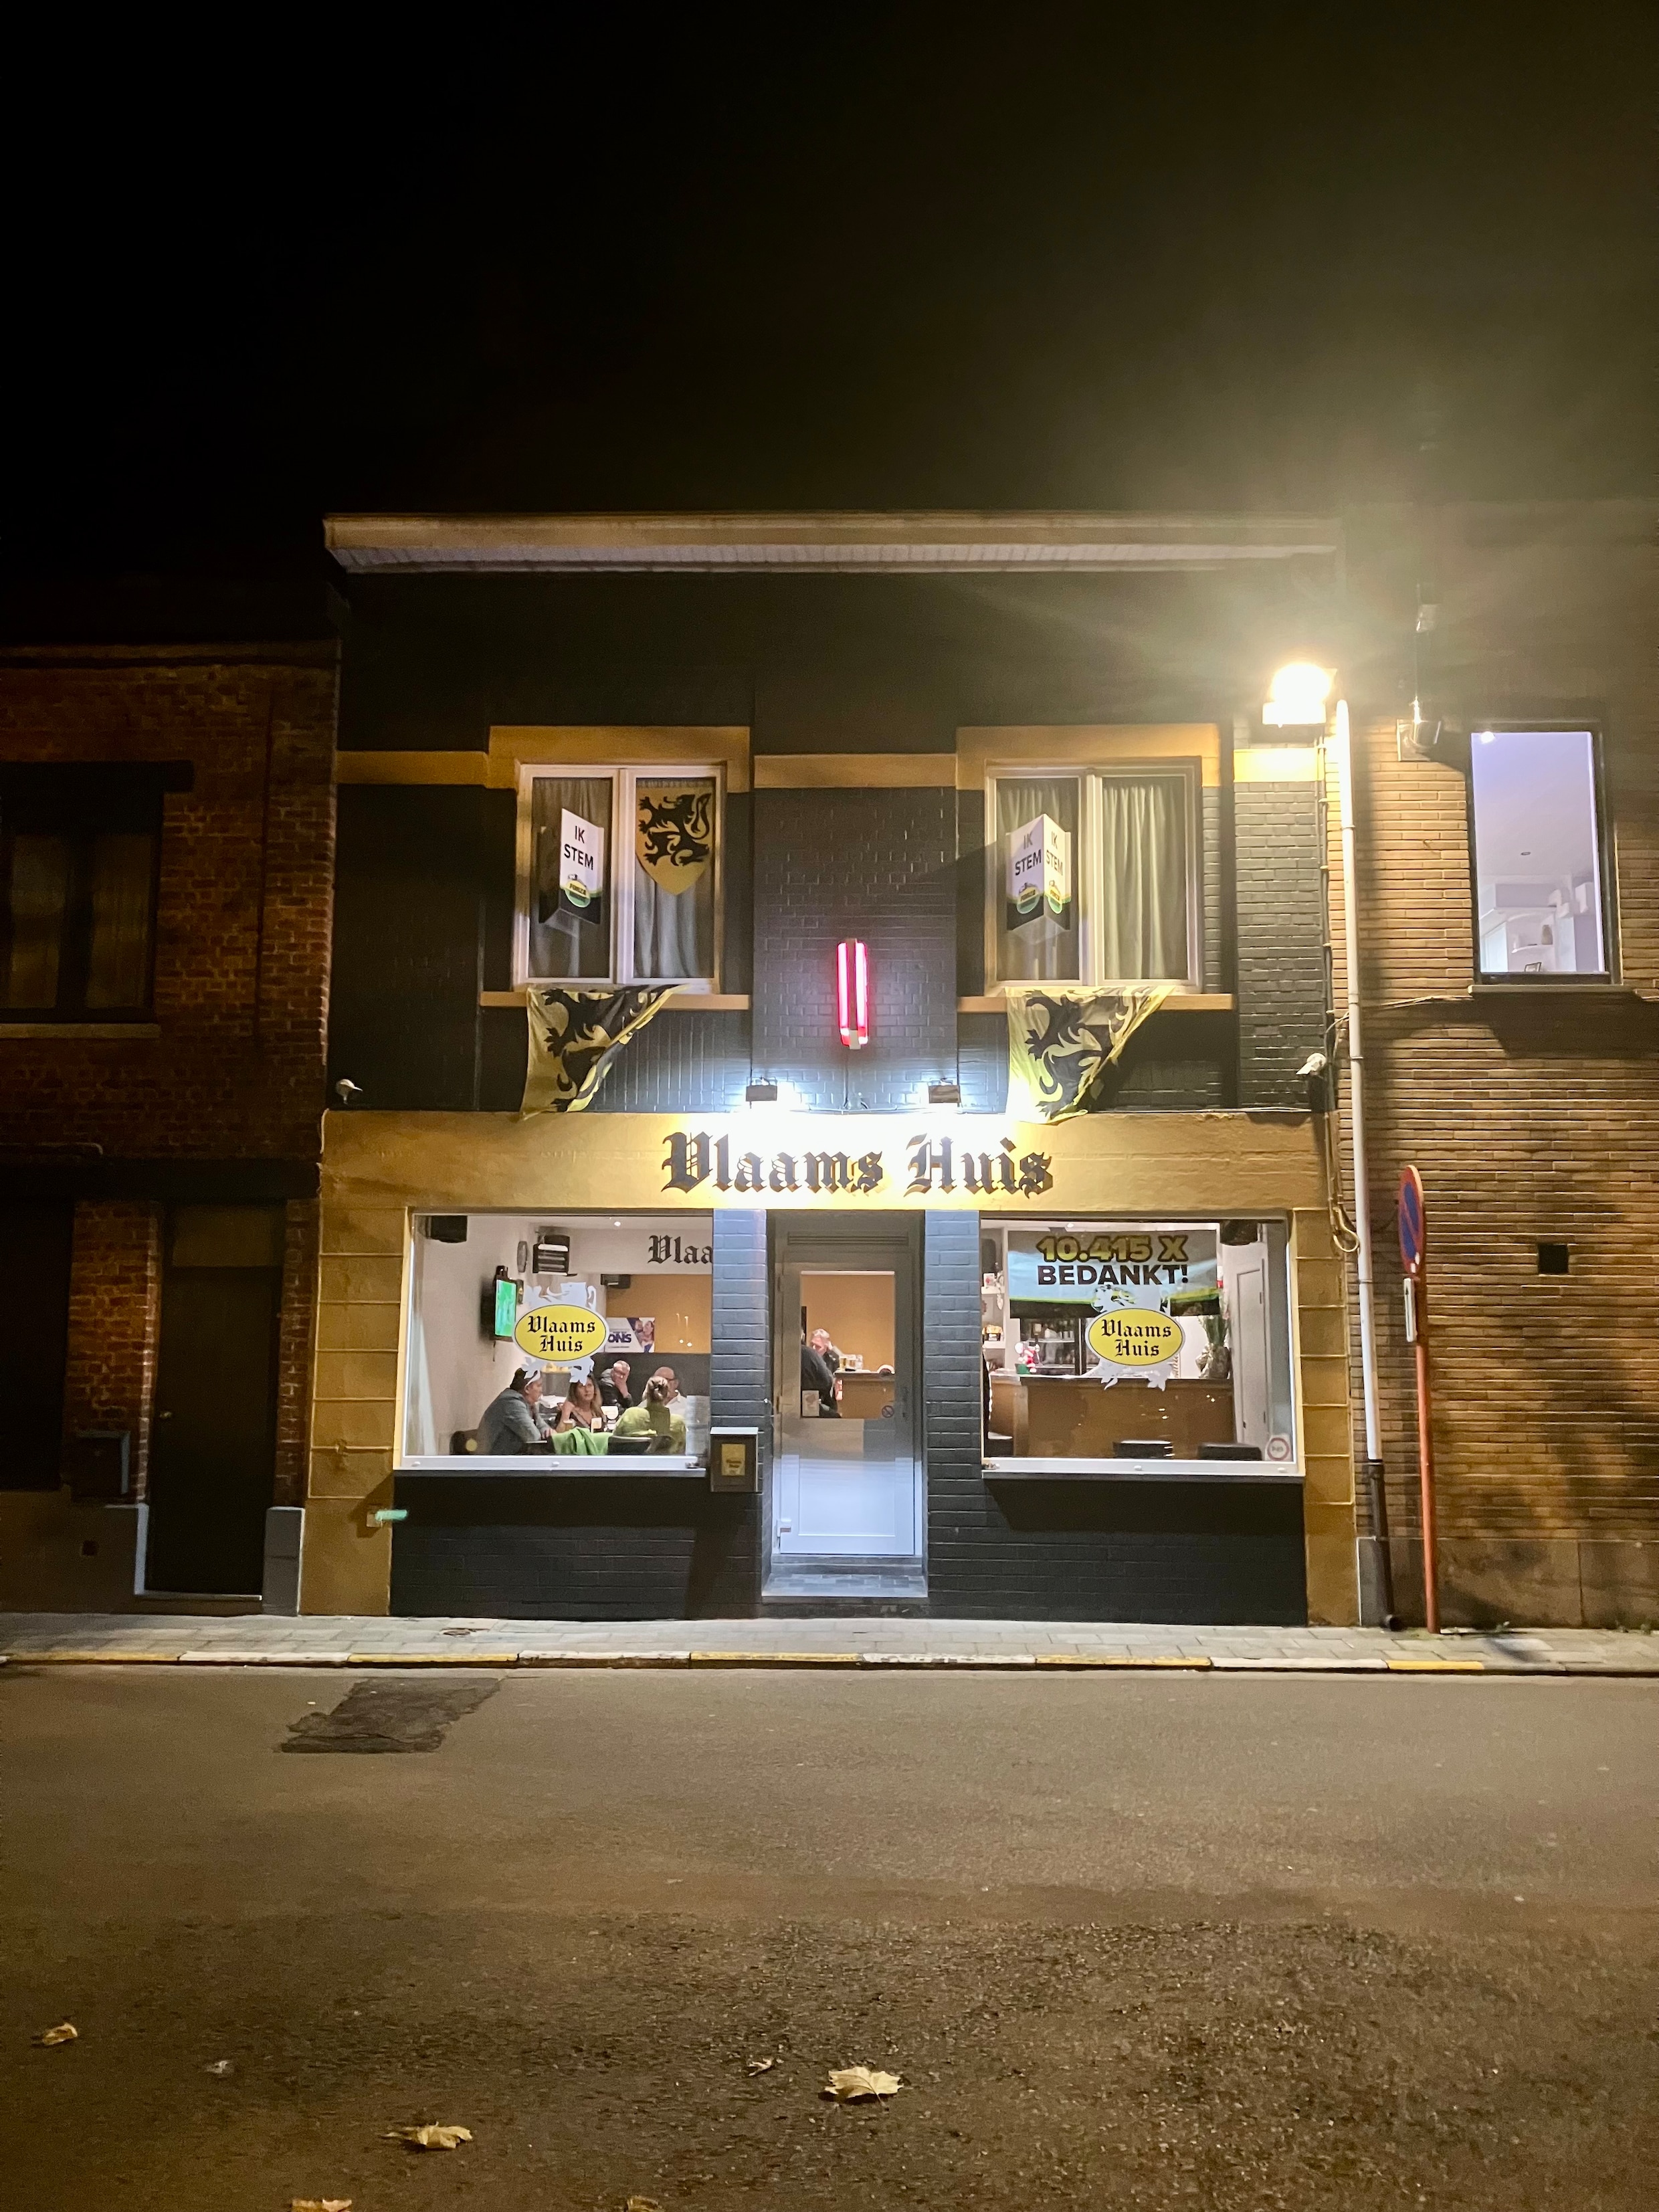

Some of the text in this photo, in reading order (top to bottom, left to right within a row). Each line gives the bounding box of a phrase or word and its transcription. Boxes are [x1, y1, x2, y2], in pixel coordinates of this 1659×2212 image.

[575, 825, 585, 844] IK
[1023, 831, 1034, 849] IK
[1051, 831, 1058, 849] IK
[564, 843, 594, 870] STEM
[1015, 849, 1042, 876] STEM
[1046, 849, 1063, 876] STEM
[660, 1132, 1054, 1199] Vlaams Huis
[1036, 1235, 1189, 1263] 10.415 X
[1038, 1264, 1189, 1286] BEDANKT!
[527, 1315, 595, 1333] Vlaams
[1101, 1319, 1171, 1337] Vlaams
[539, 1335, 583, 1352] Huis
[1114, 1339, 1159, 1357] Huis
